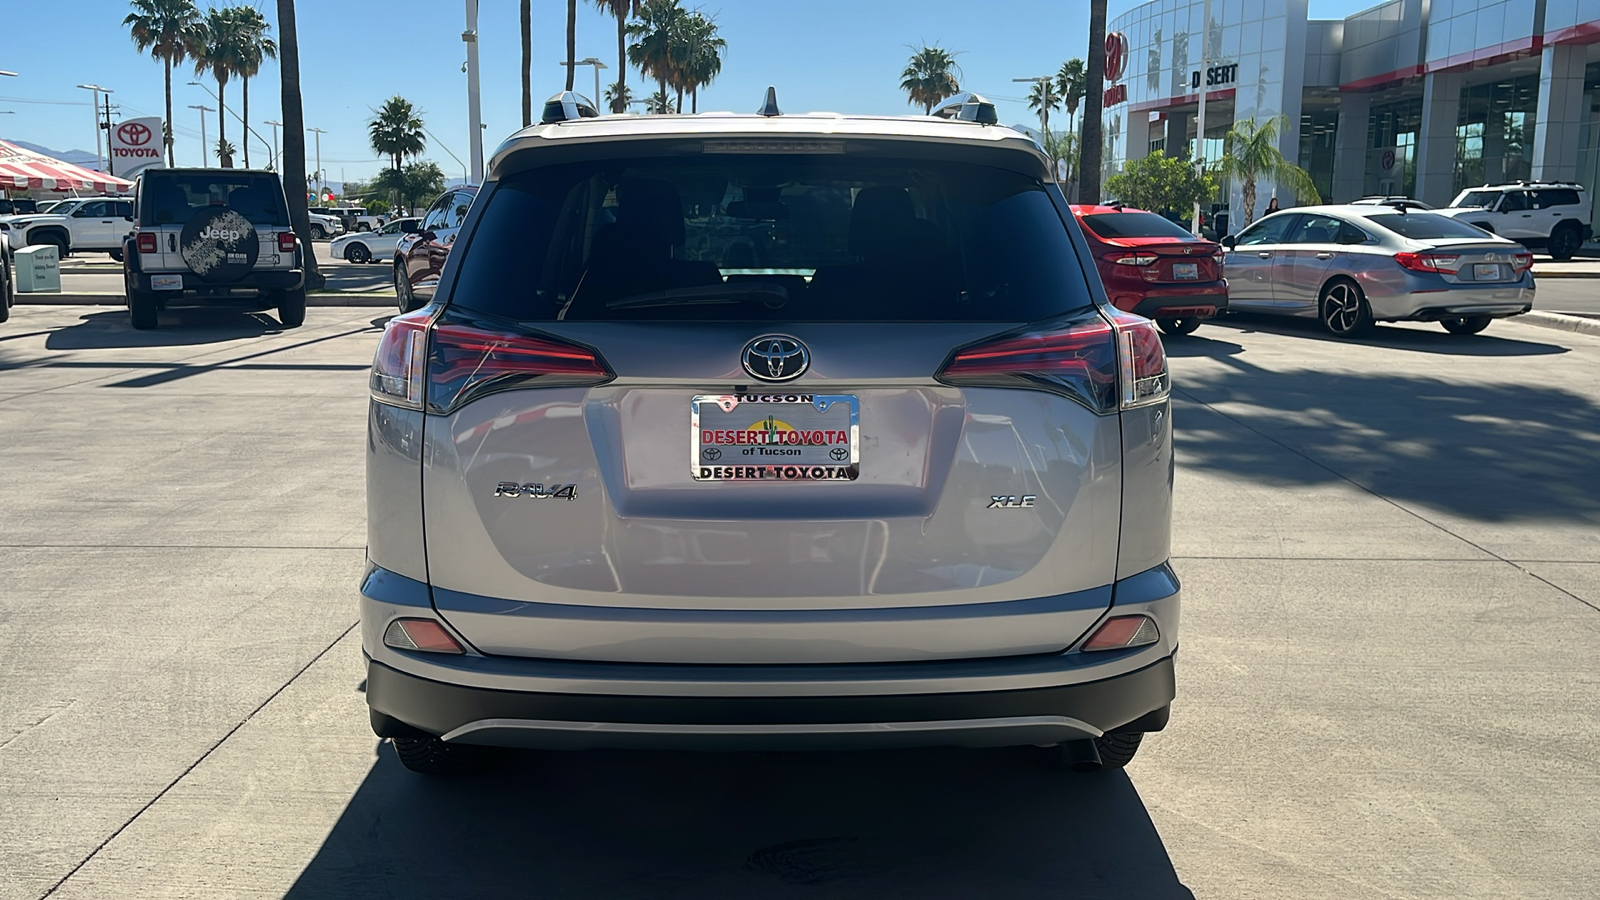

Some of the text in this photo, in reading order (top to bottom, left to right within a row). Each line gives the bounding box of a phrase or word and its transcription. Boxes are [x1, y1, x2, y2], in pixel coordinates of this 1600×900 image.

[1192, 64, 1238, 88] DSERT
[113, 148, 159, 157] TOYOTA
[200, 226, 240, 241] Jeep
[734, 394, 814, 403] TUCSON
[702, 430, 848, 445] DESERT TOYOTA
[742, 447, 801, 456] of Tucson
[700, 467, 848, 479] DESERT TOYOTA
[494, 482, 578, 500] RAV4
[987, 495, 1036, 508] XLE
